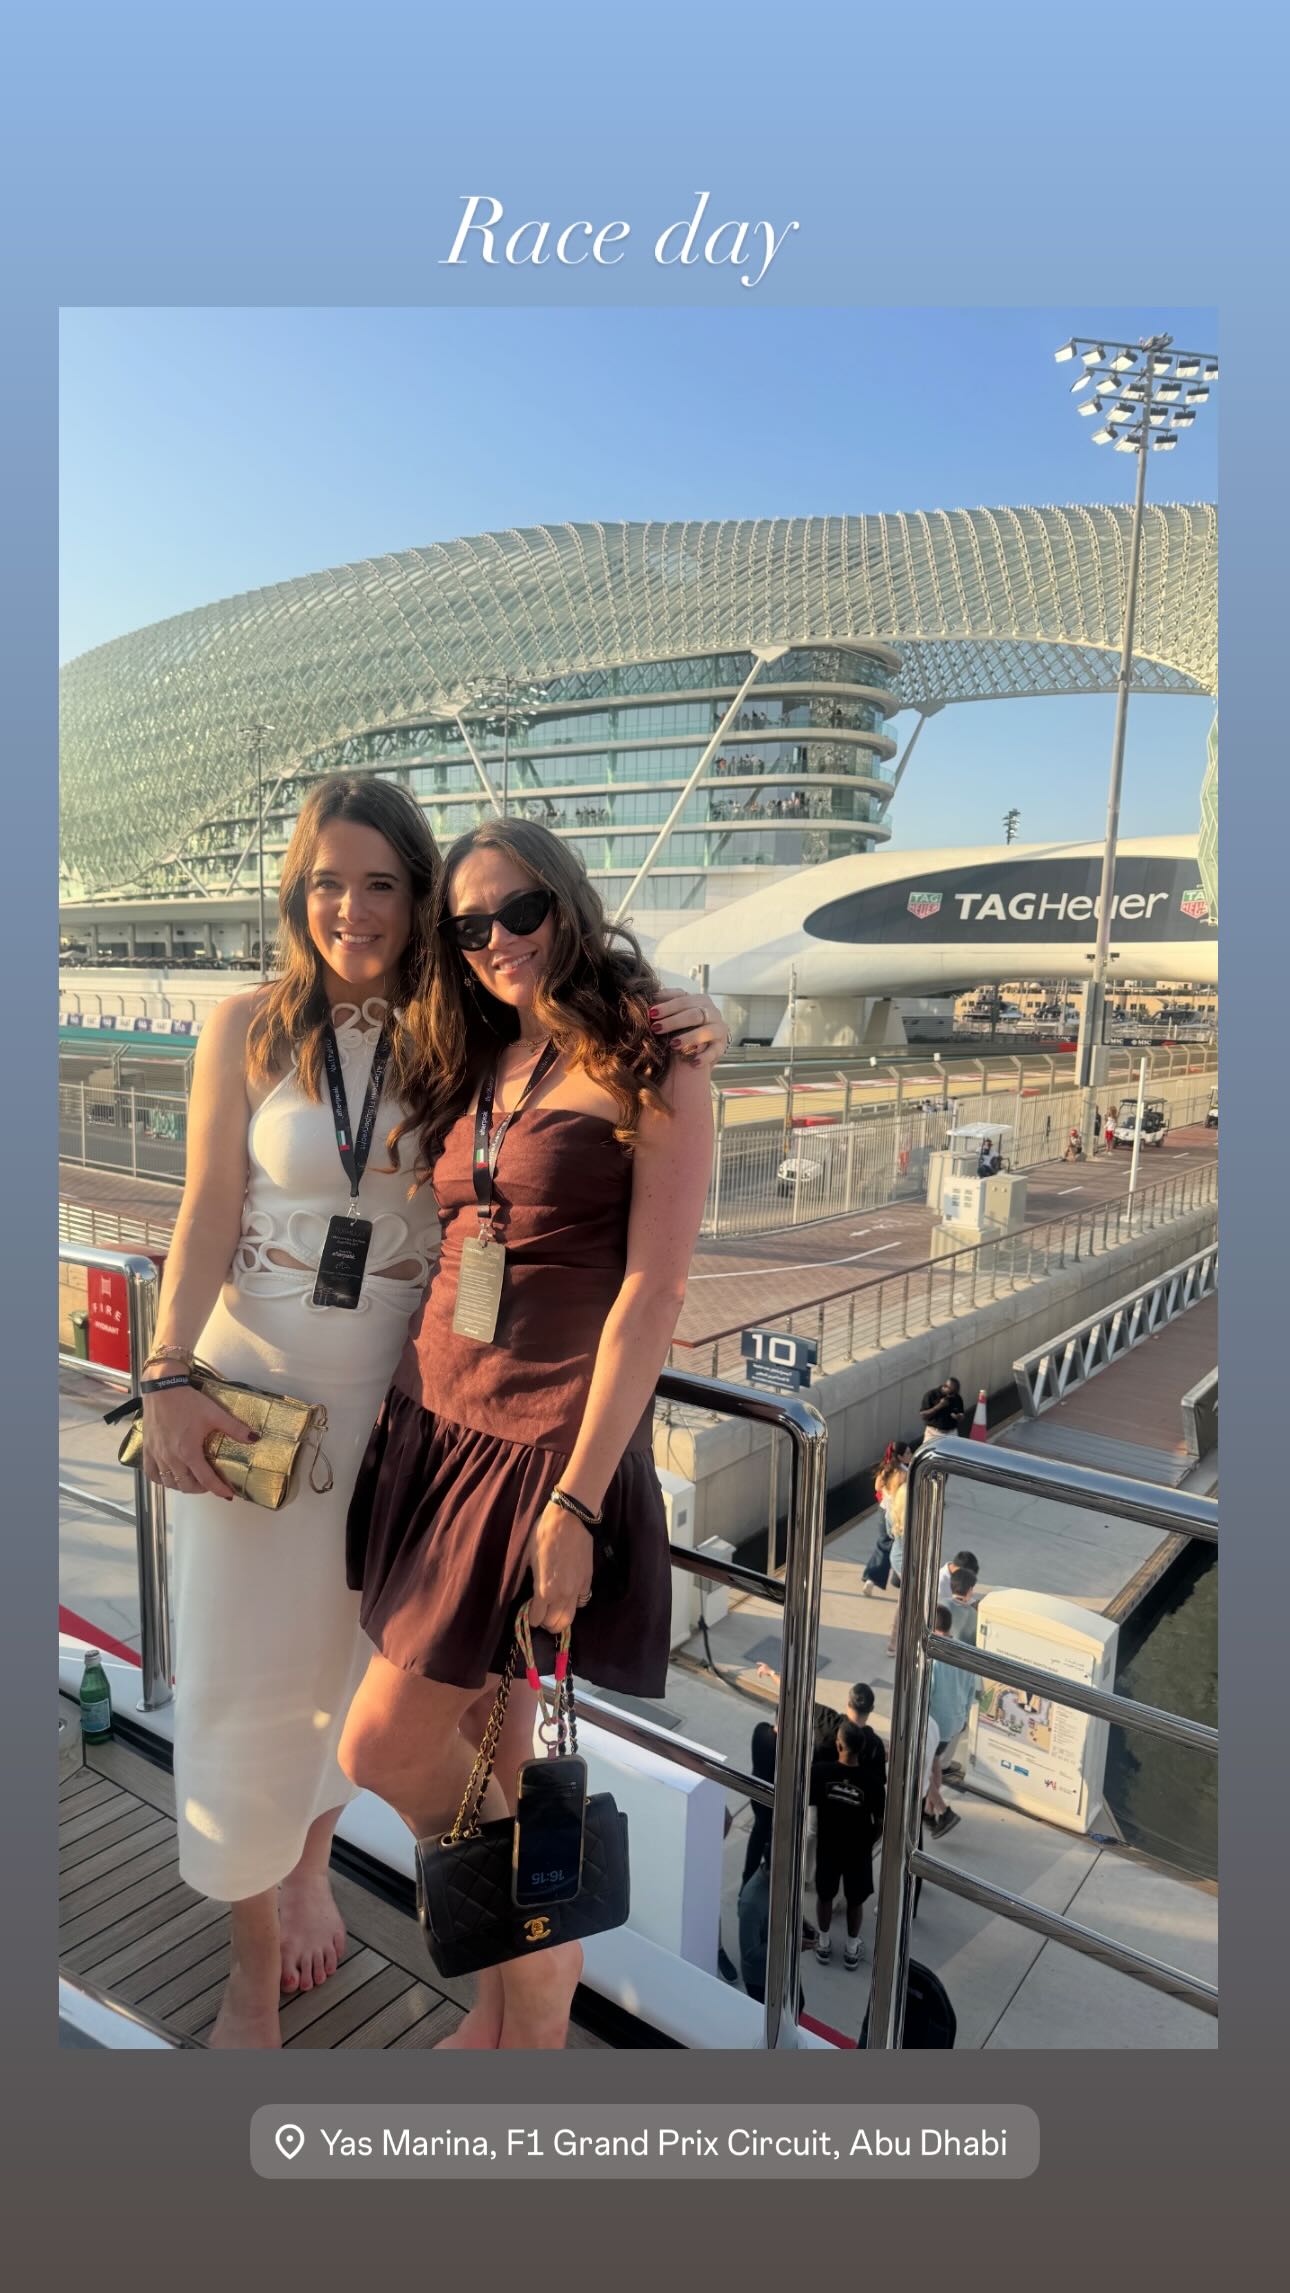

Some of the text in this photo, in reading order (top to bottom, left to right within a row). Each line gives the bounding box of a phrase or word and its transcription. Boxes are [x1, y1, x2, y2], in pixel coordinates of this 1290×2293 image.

[911, 894, 939, 902] TAG
[92, 1302, 122, 1321] FIRE
[752, 1333, 797, 1367] 10
[531, 1869, 565, 1885] 16:15
